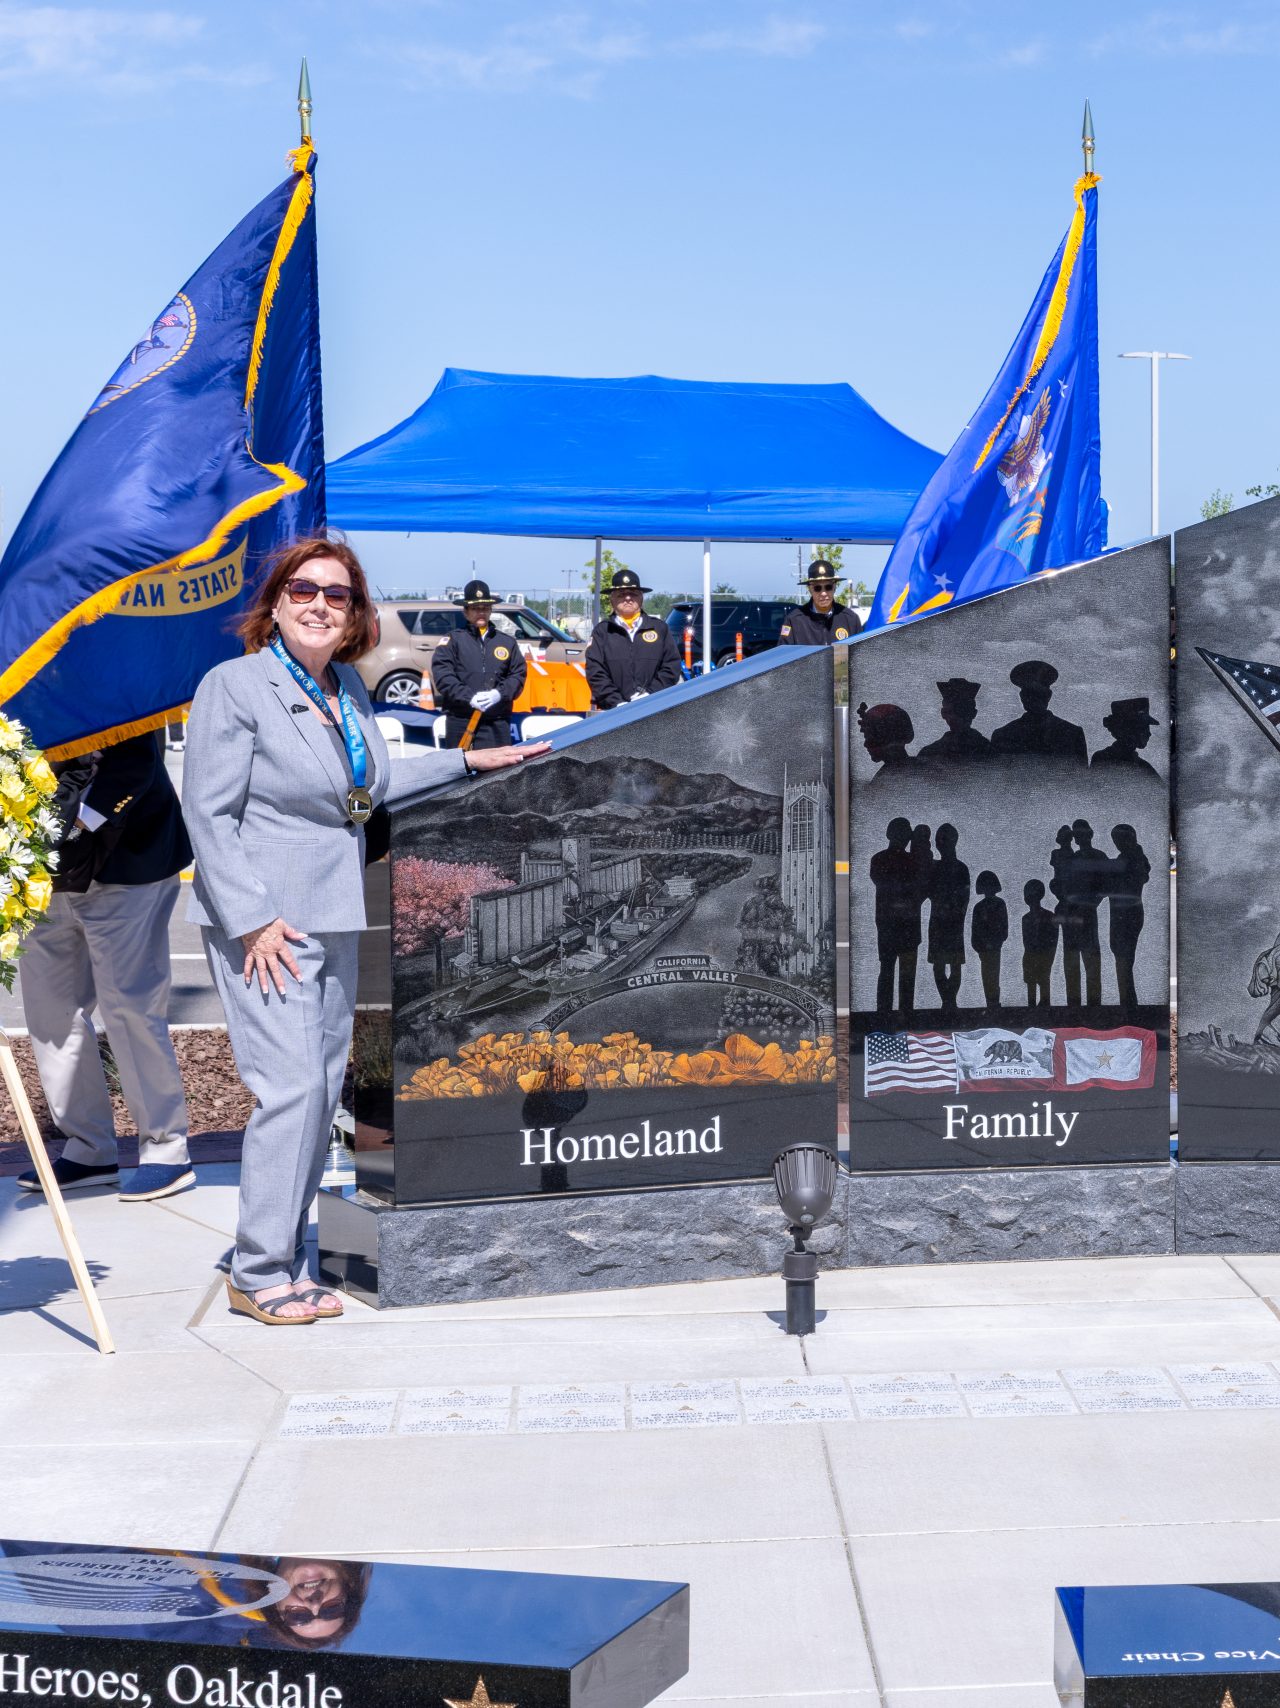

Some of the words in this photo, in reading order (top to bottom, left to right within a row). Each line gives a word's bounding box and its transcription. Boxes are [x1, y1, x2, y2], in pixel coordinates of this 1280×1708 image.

[656, 957, 708, 968] CALIFORNIA
[627, 970, 683, 989] CENTRAL
[692, 970, 739, 984] VALLEY
[943, 1101, 1080, 1147] Family
[519, 1115, 724, 1167] Homeland
[1121, 1652, 1206, 1663] Chair
[166, 1664, 343, 1708] Oakdale
